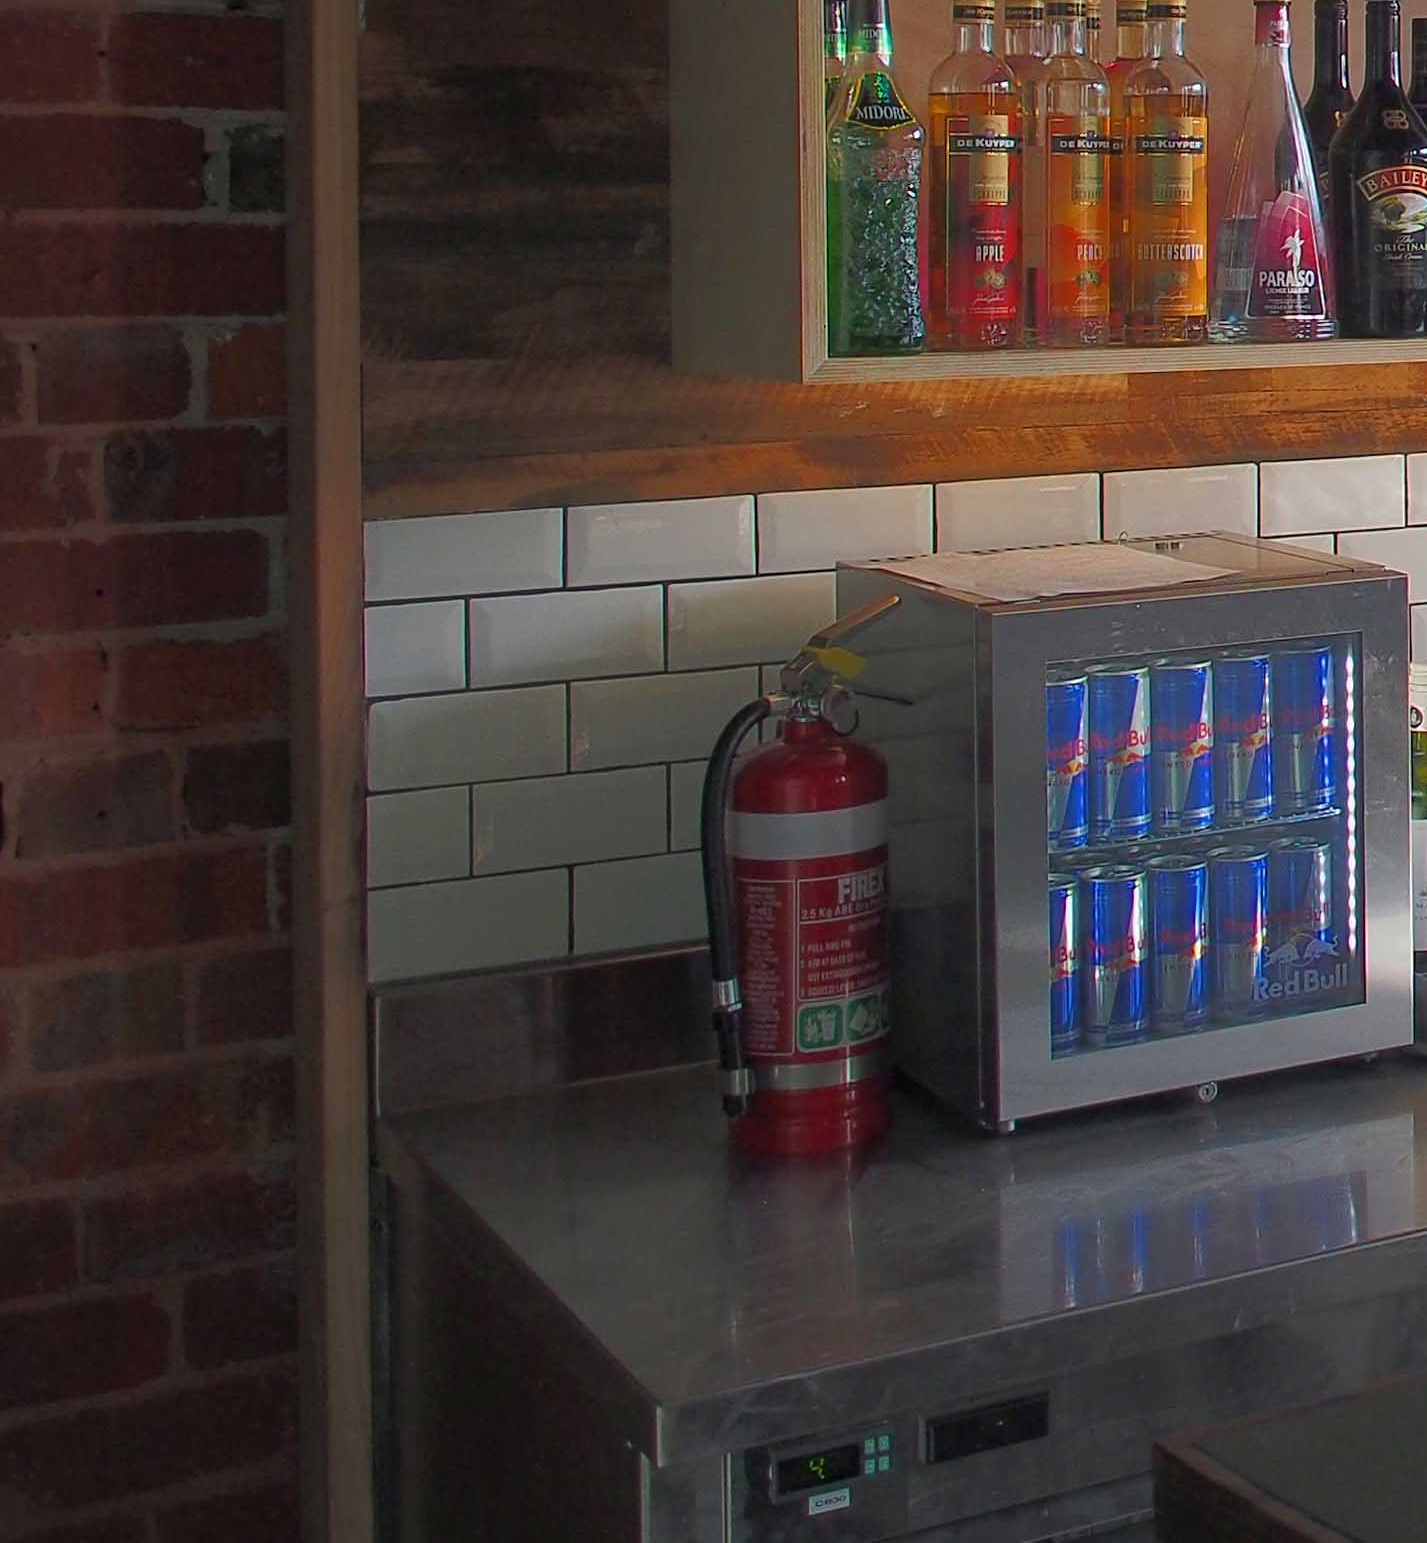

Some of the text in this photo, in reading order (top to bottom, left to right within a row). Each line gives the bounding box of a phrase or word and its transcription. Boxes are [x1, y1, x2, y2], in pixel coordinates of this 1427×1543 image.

[855, 104, 908, 121] MIDORI
[1162, 139, 1202, 149] KUYPER
[976, 245, 1005, 262] APPLE
[1253, 962, 1348, 1004] Red Bull
